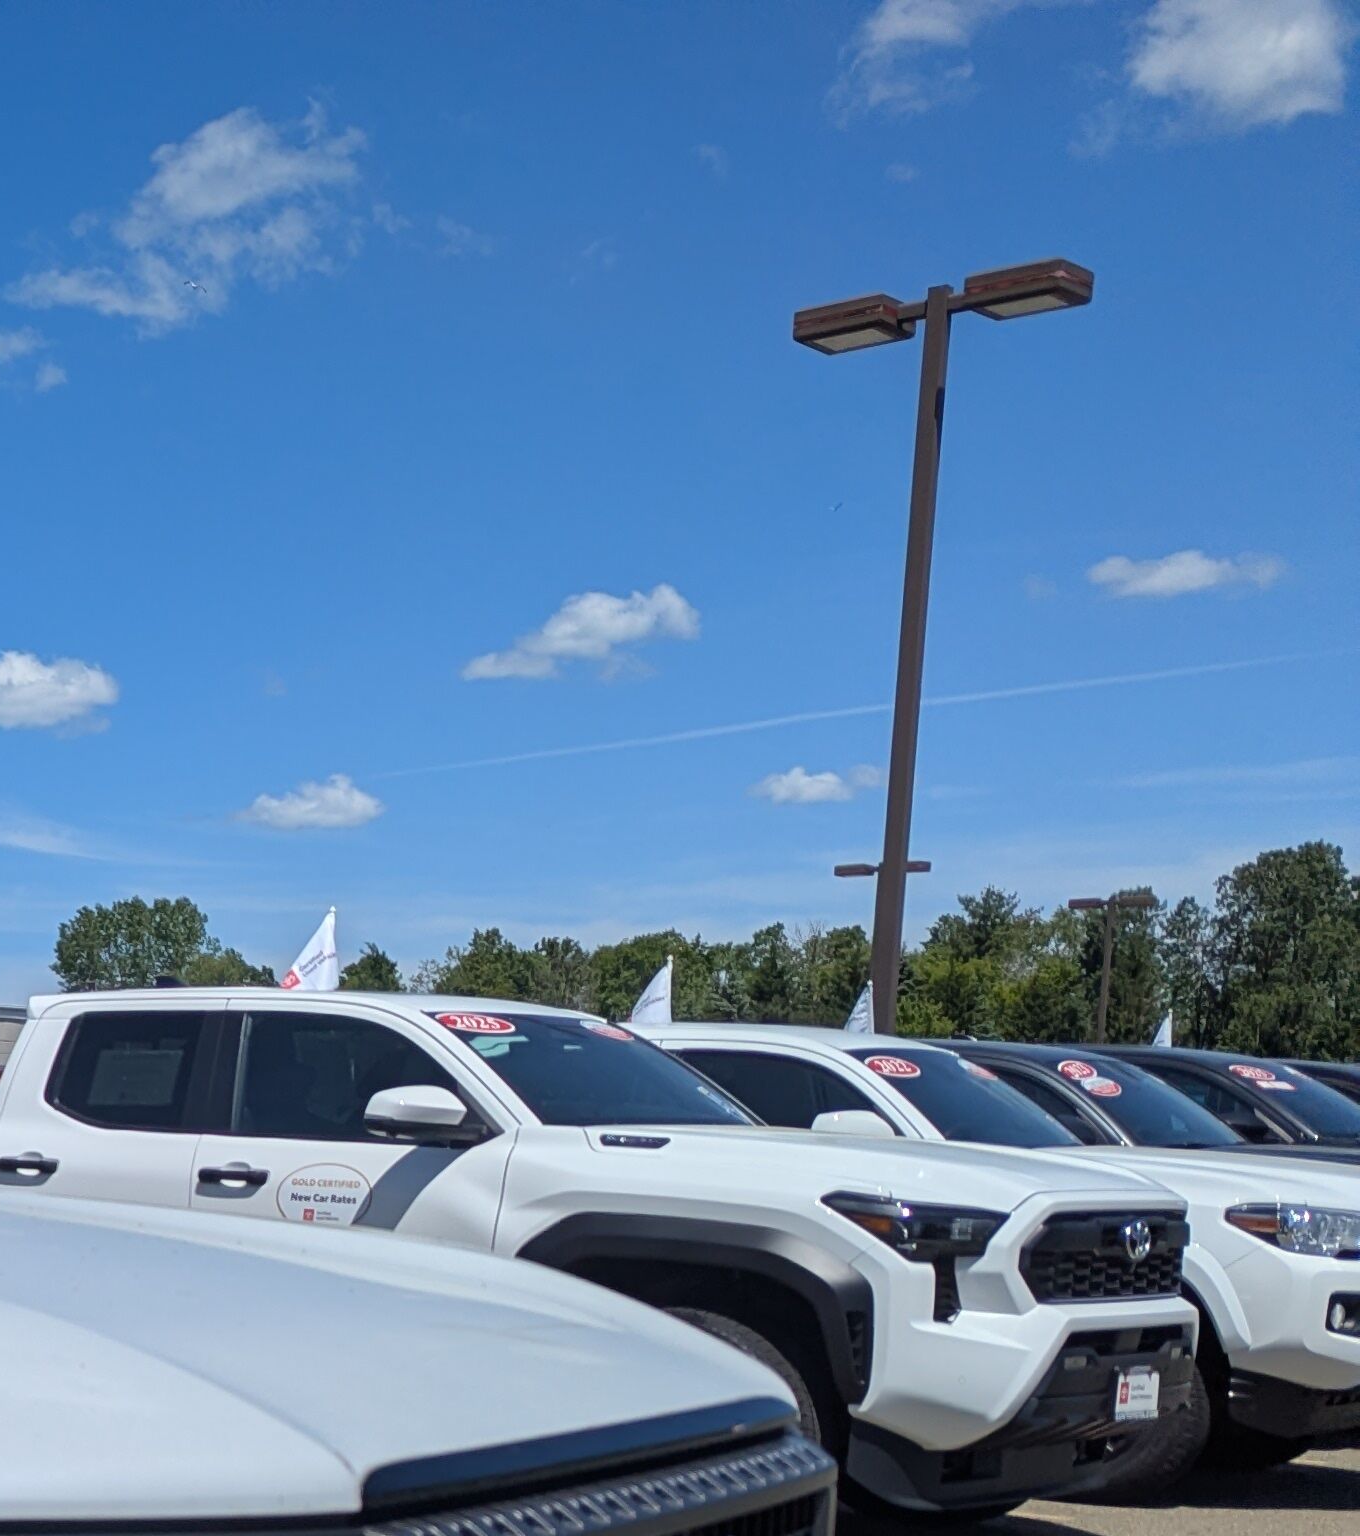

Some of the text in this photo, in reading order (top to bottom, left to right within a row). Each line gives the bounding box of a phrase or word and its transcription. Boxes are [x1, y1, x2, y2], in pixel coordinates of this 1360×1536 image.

[449, 1015, 500, 1029] 2025
[291, 1178, 361, 1188] GOLD CERTIFIED
[290, 1193, 357, 1204] New Car Rates
